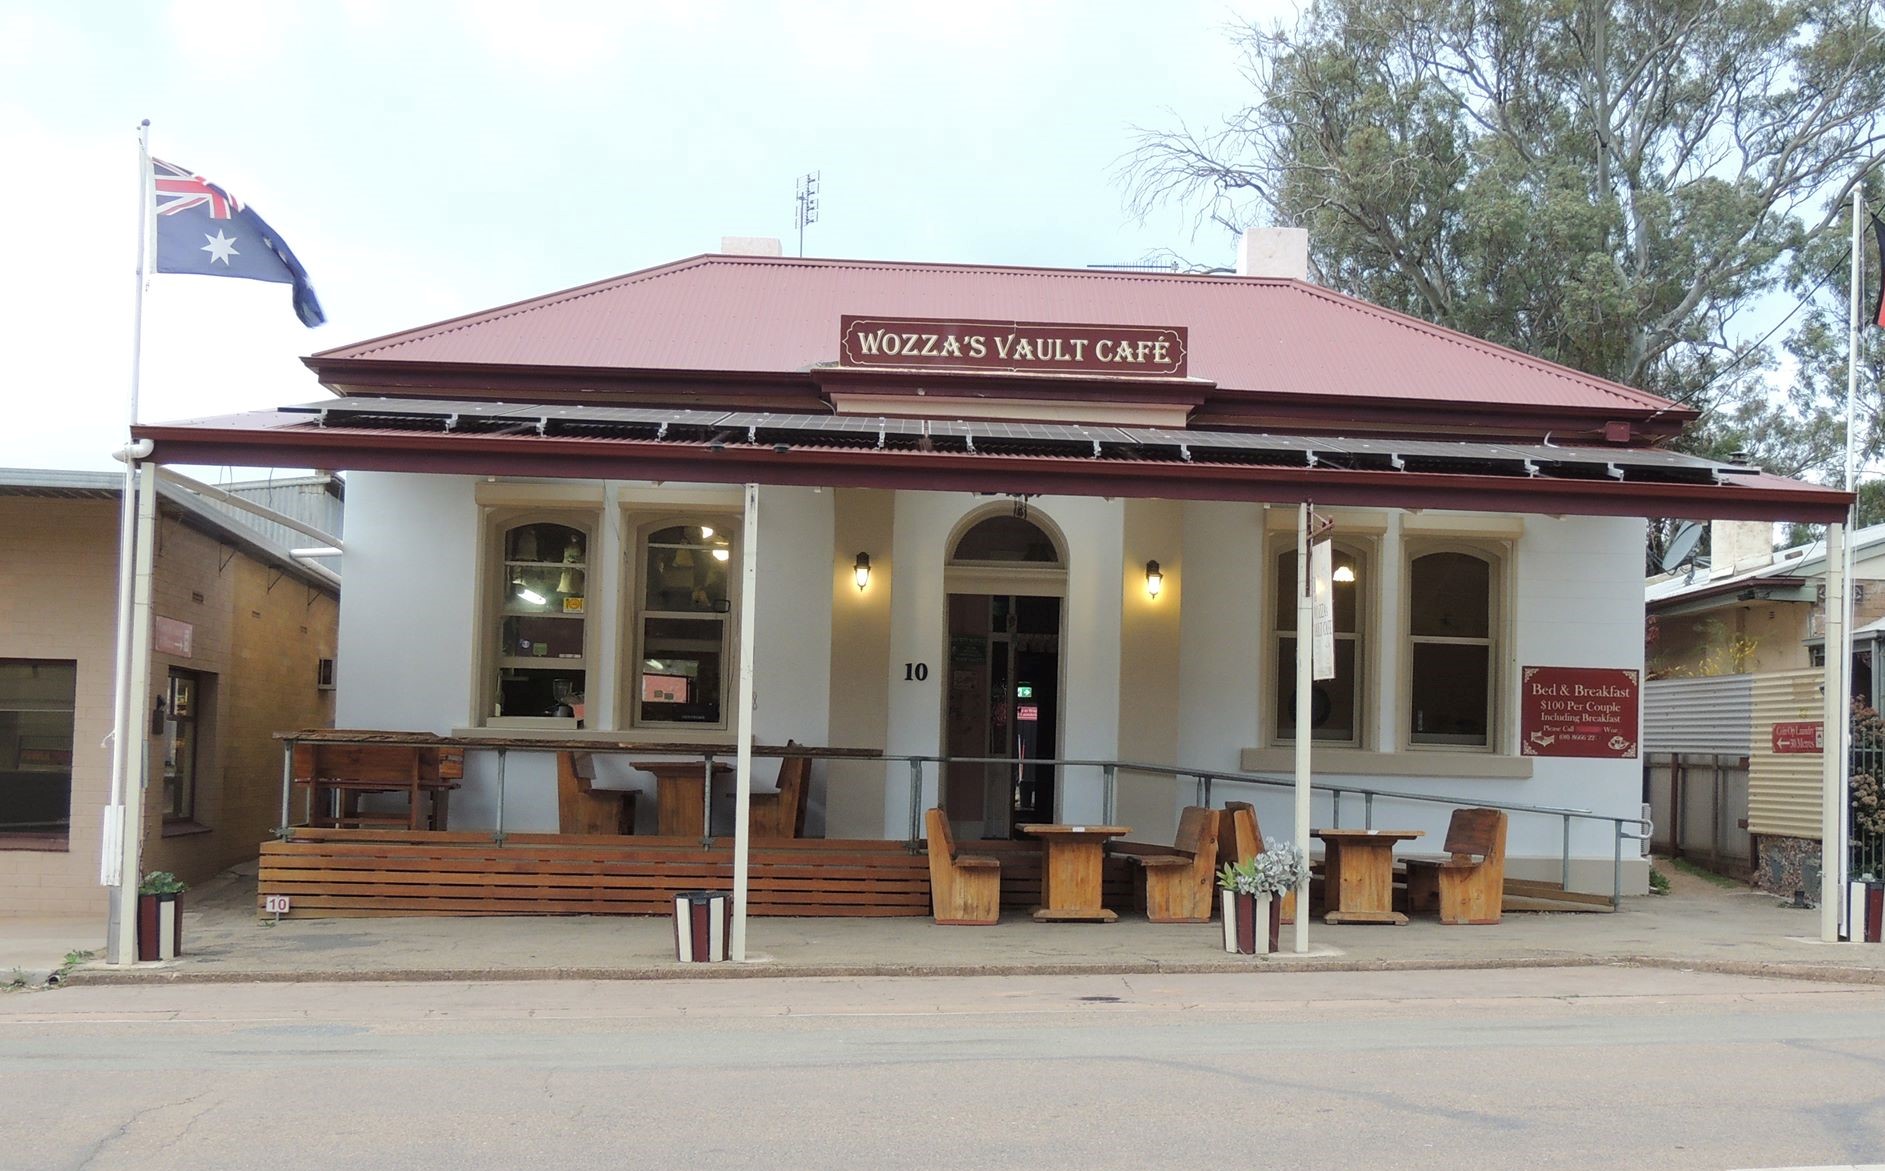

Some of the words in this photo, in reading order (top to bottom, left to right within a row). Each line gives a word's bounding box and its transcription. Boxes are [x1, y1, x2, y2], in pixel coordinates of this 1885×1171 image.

[857, 328, 988, 359] WOZZA'S
[994, 332, 1089, 363] VAULT
[1095, 336, 1173, 364] CAFÉ
[904, 662, 929, 681] 10
[1532, 683, 1557, 696] Bed
[1560, 684, 1571, 696] &
[1574, 684, 1630, 698] Breakfast
[1540, 699, 1565, 711] $100
[1567, 700, 1584, 711] Per
[1586, 701, 1621, 714] Couple
[1541, 712, 1580, 723] Including
[1582, 713, 1621, 723] Breakfast
[269, 898, 287, 911] 10
